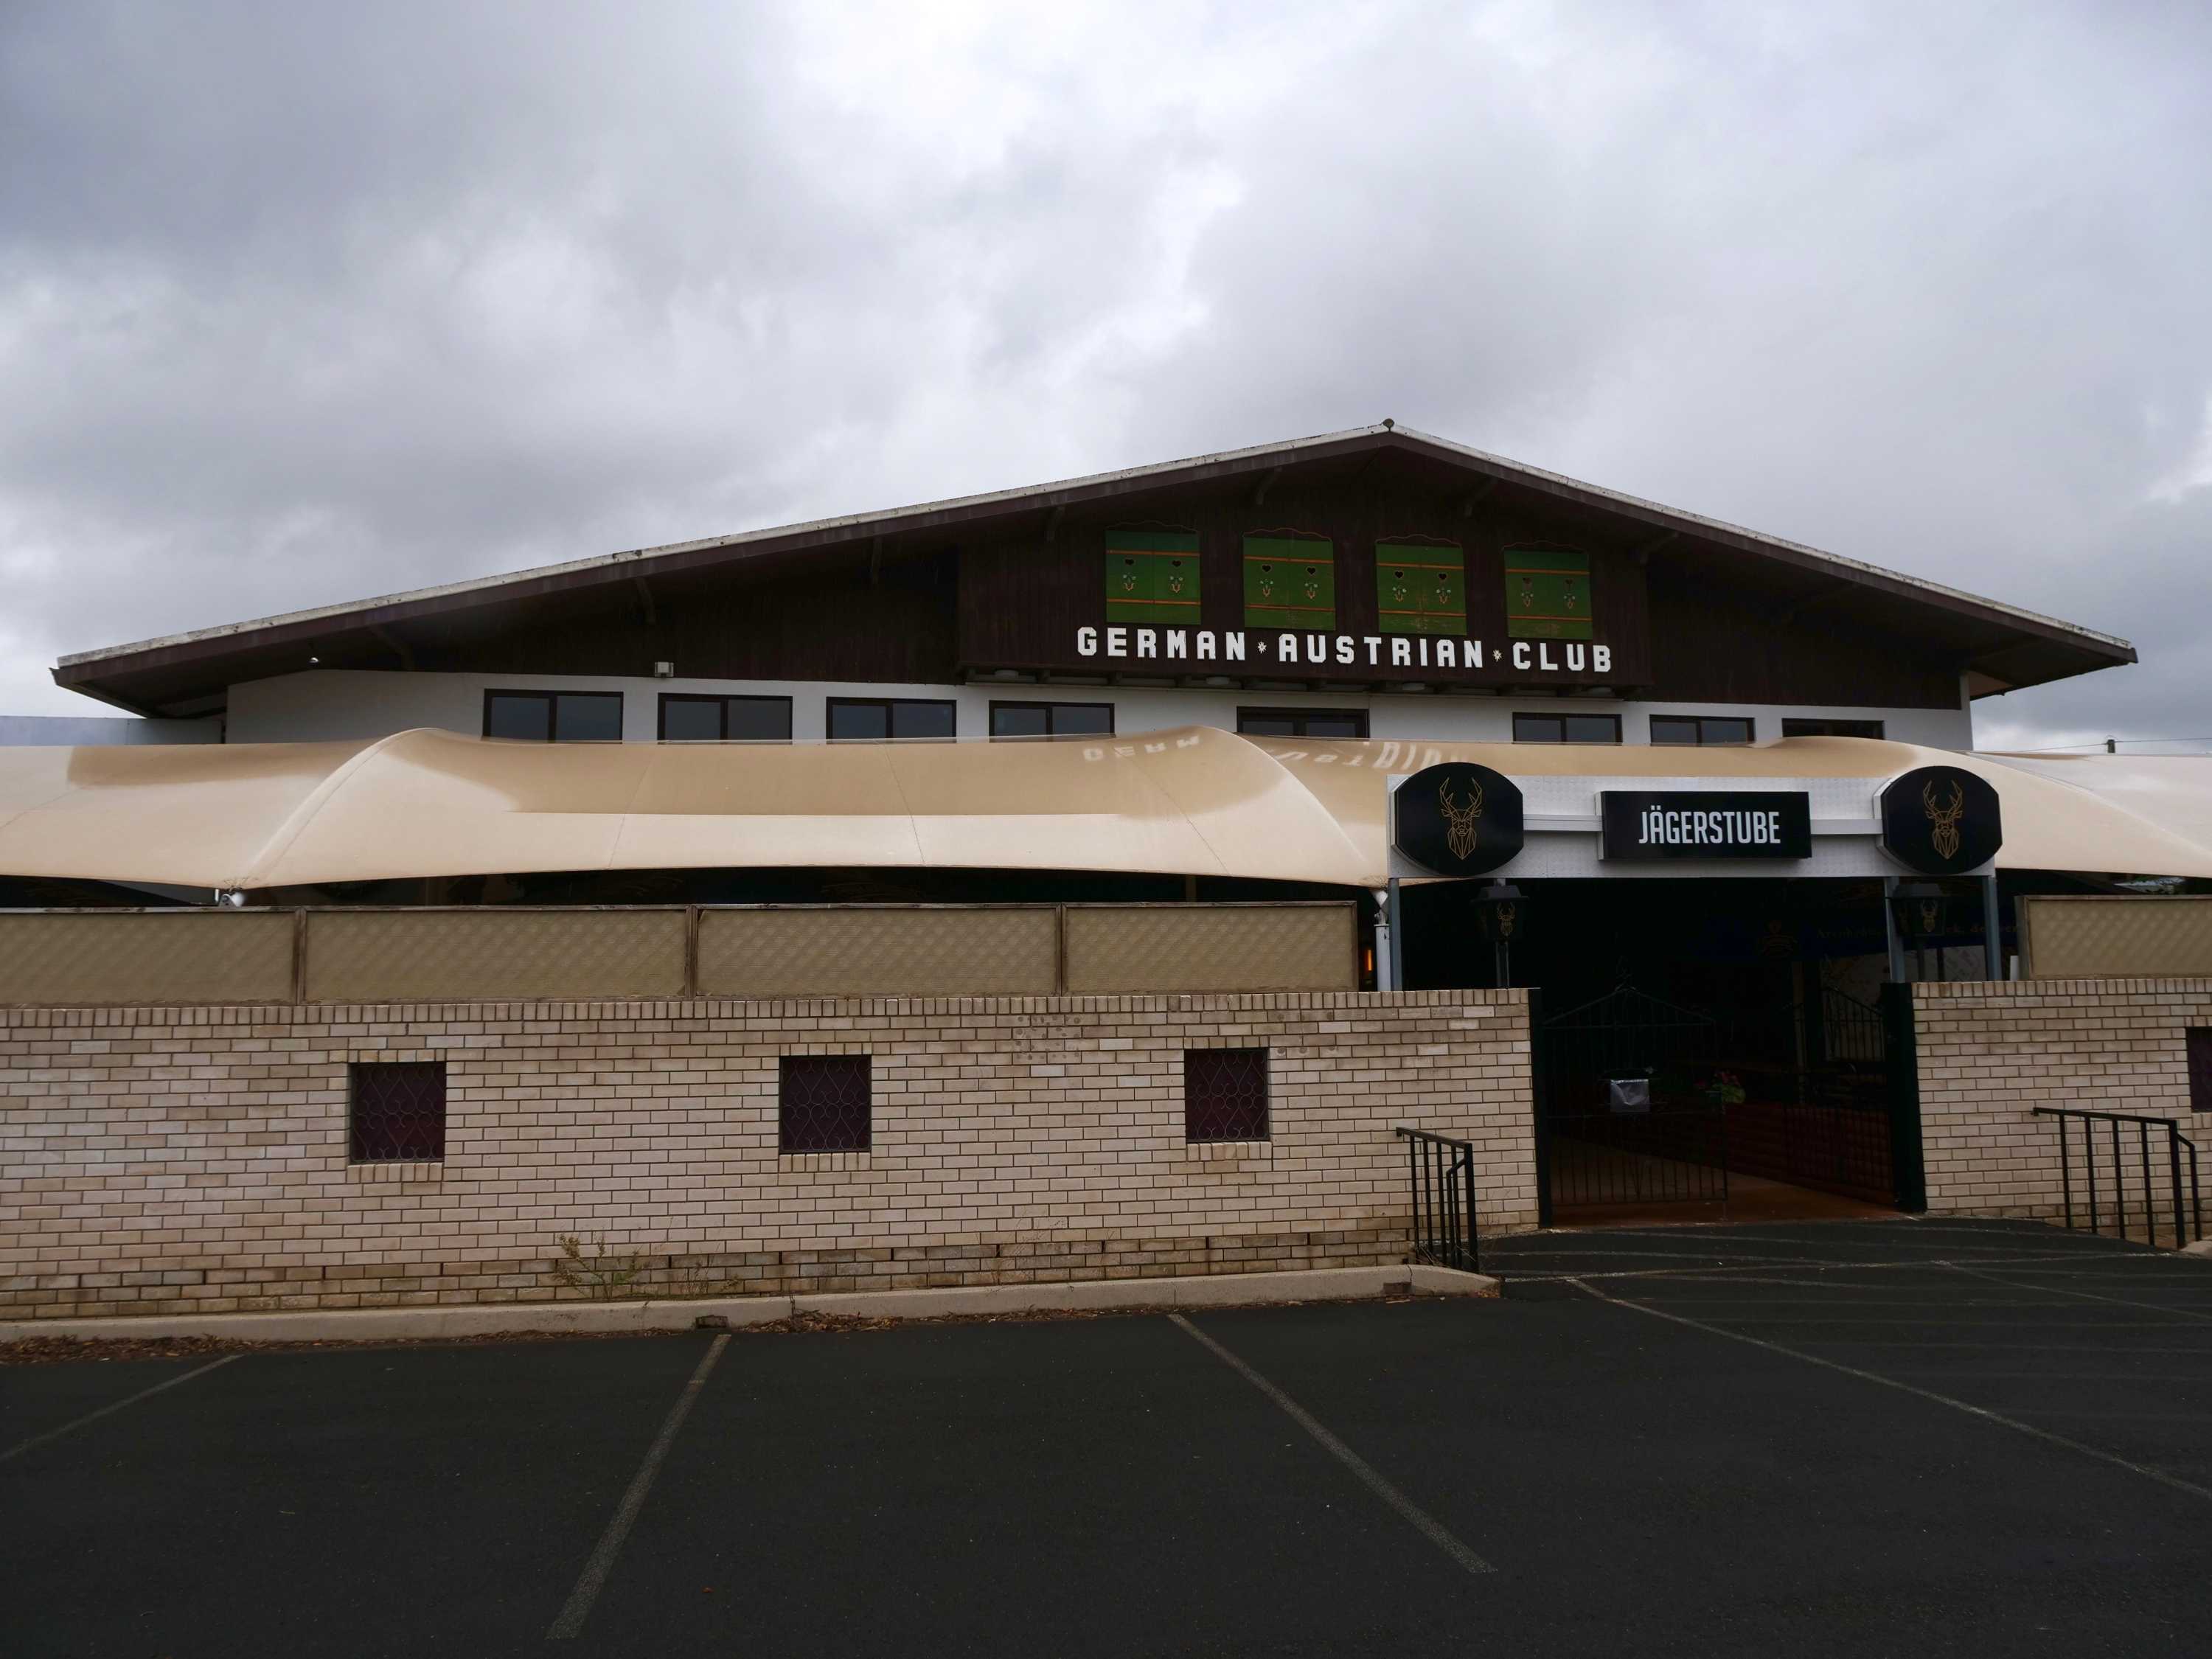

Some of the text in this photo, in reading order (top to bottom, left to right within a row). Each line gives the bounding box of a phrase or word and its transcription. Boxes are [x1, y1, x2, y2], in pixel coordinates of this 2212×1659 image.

[1078, 627, 1610, 672] GERMAN AUSTRIAN CLUB
[1639, 805, 1780, 844] JÄGERSTUBE
